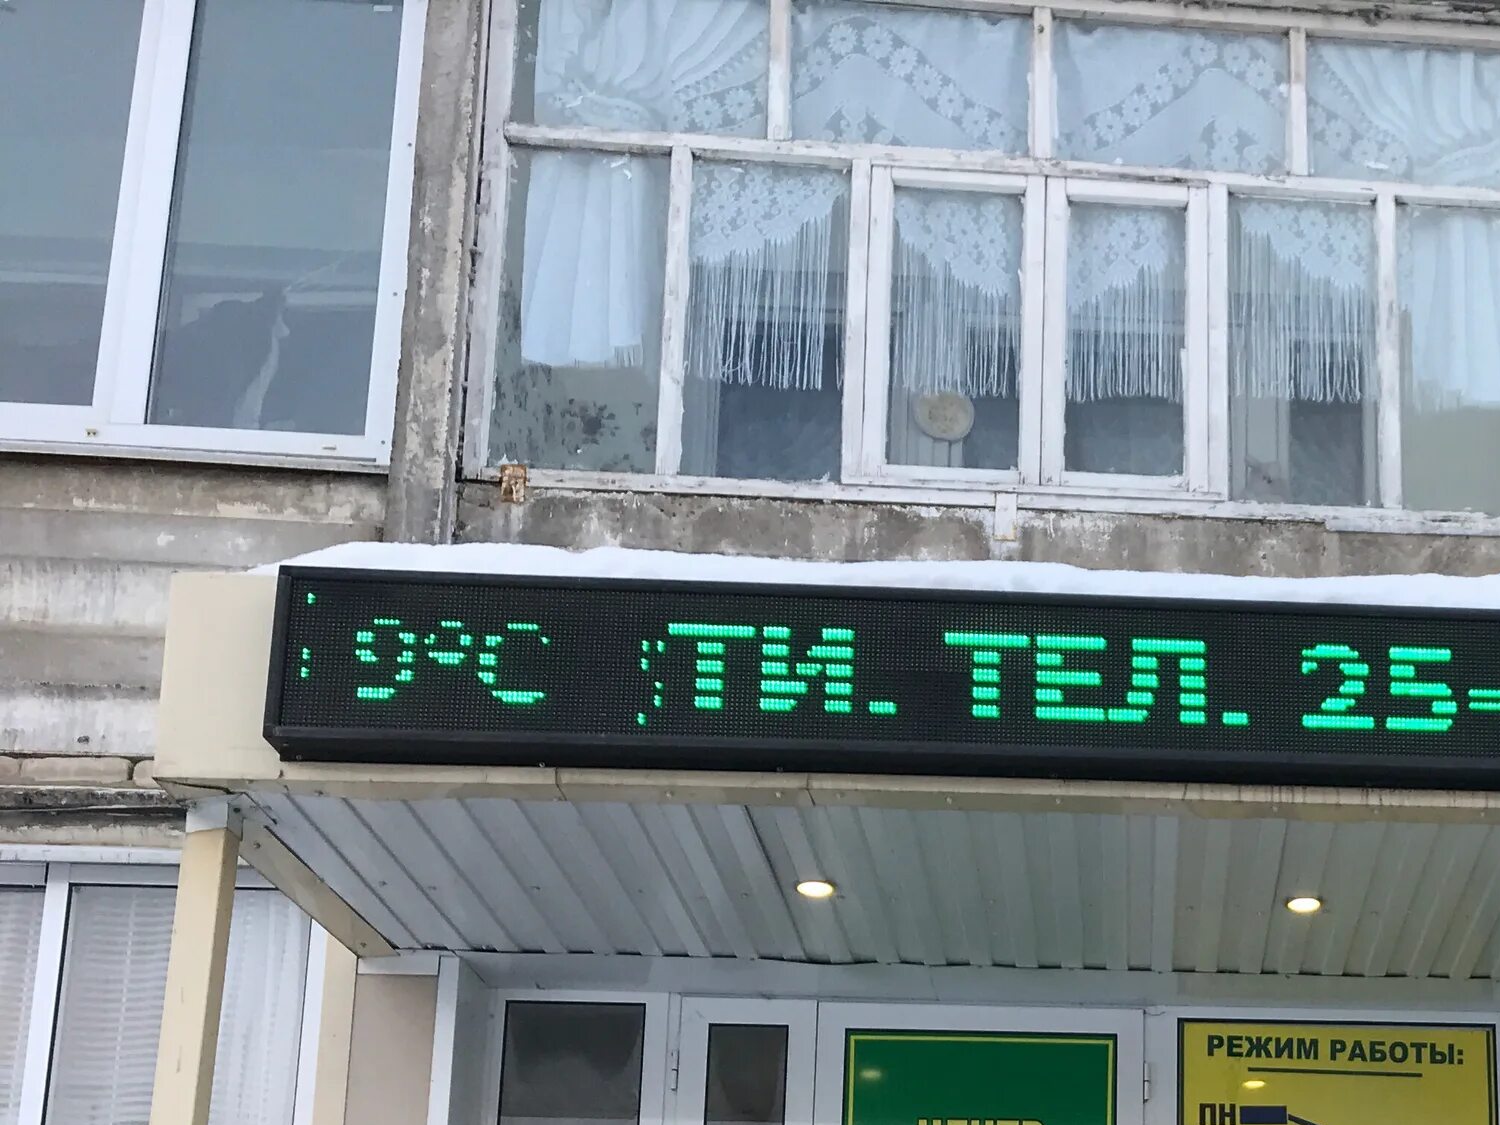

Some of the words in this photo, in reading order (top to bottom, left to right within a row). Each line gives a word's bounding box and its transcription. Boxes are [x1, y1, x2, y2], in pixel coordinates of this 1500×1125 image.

[944, 632, 1249, 726] ТЕЛ.
[1207, 1034, 1319, 1061] РЕЖИМ
[1330, 1038, 1465, 1066] РАБОТЫ:
